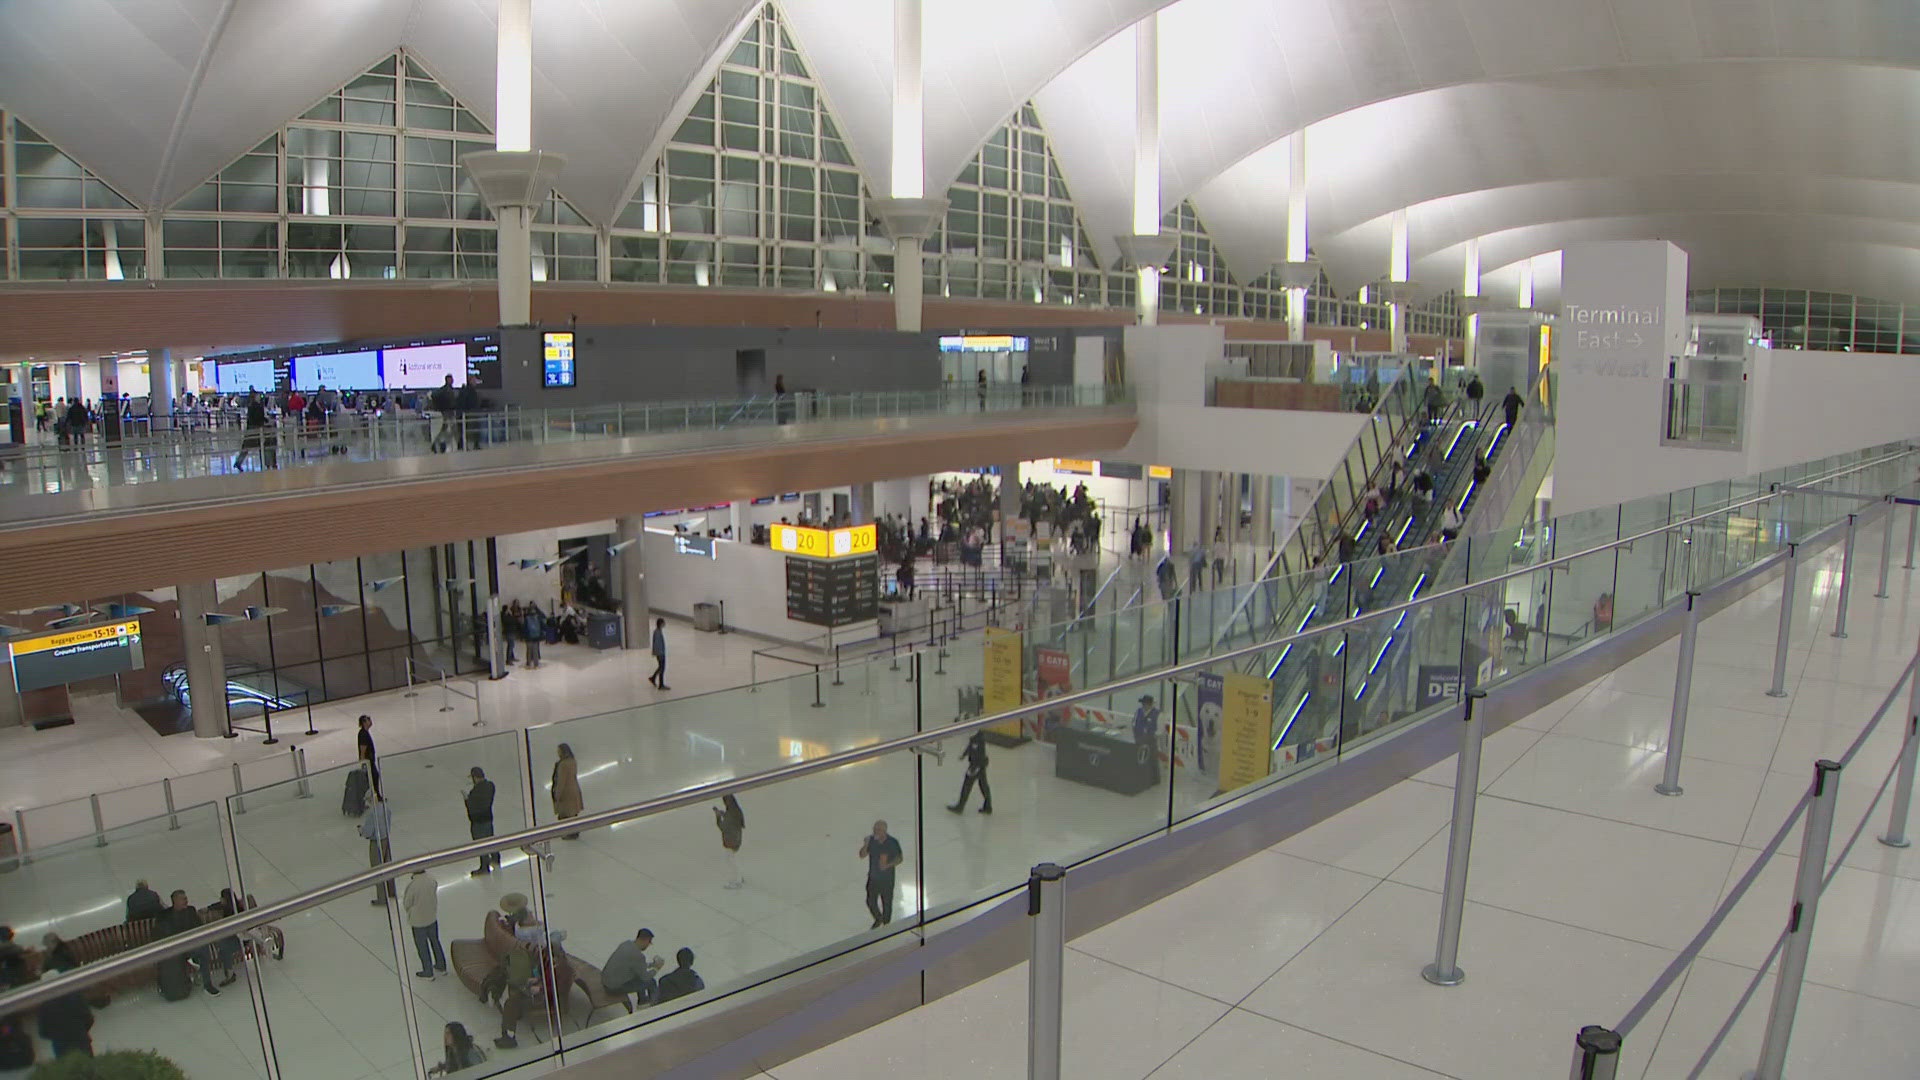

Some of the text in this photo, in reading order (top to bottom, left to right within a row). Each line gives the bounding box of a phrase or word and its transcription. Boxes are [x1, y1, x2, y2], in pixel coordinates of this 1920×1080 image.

[1566, 304, 1660, 325] Terminal
[1578, 331, 1620, 349] East
[1595, 360, 1649, 378] West
[799, 533, 814, 549] 20
[853, 532, 870, 548] 20
[51, 627, 116, 645] Baggage Claim 15-19
[54, 640, 117, 657] Ground Transportation
